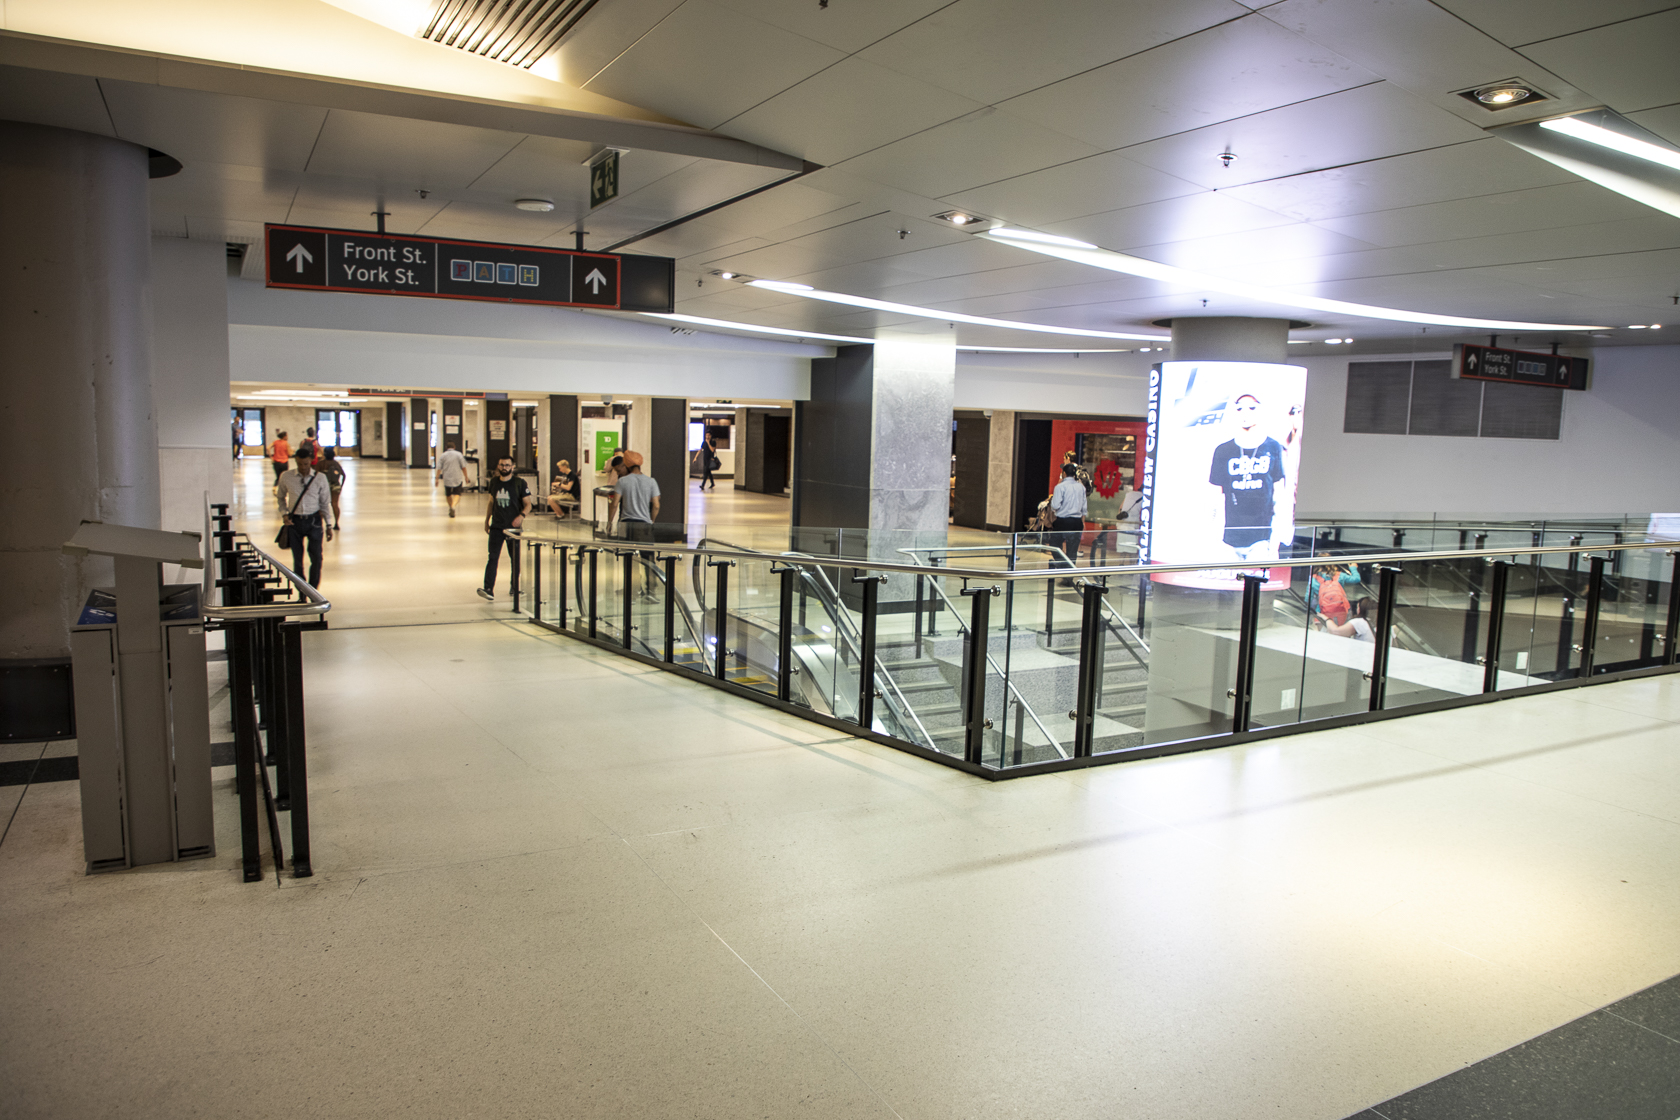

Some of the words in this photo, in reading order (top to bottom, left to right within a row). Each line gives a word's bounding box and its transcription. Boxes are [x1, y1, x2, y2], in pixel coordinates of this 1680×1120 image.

[343, 242, 397, 264] Front
[403, 247, 427, 264] St.
[343, 264, 389, 283] York
[394, 268, 420, 285] St.
[453, 261, 537, 285] PATH
[1485, 352, 1502, 362] Front
[1503, 354, 1512, 364] St.
[1484, 364, 1499, 374] York
[1500, 366, 1509, 375] St.
[1145, 369, 1160, 453] CASINO
